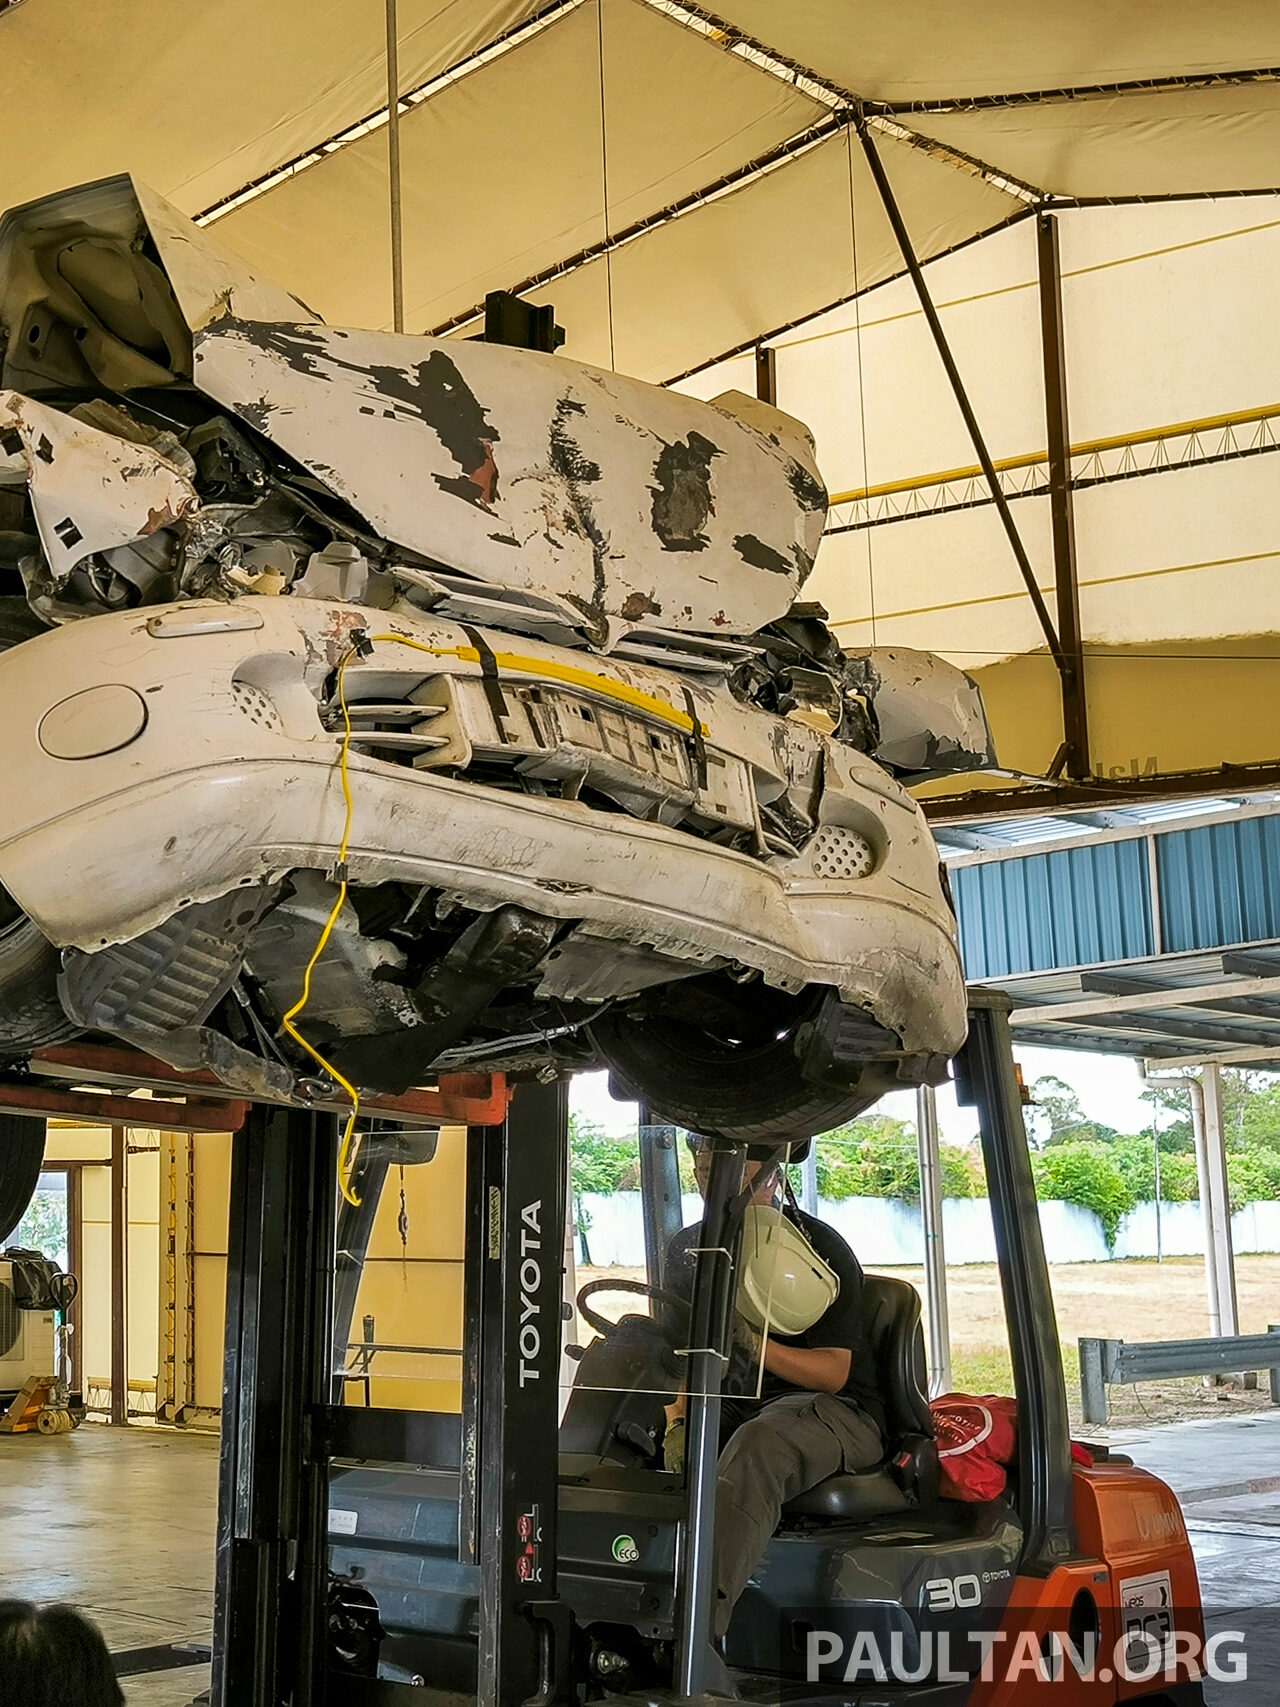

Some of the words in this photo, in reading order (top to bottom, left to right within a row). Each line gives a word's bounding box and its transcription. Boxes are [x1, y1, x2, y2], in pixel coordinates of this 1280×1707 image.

[520, 1200, 541, 1388] TOYOTA
[620, 1548, 639, 1561] ECO
[926, 1574, 982, 1613] 30
